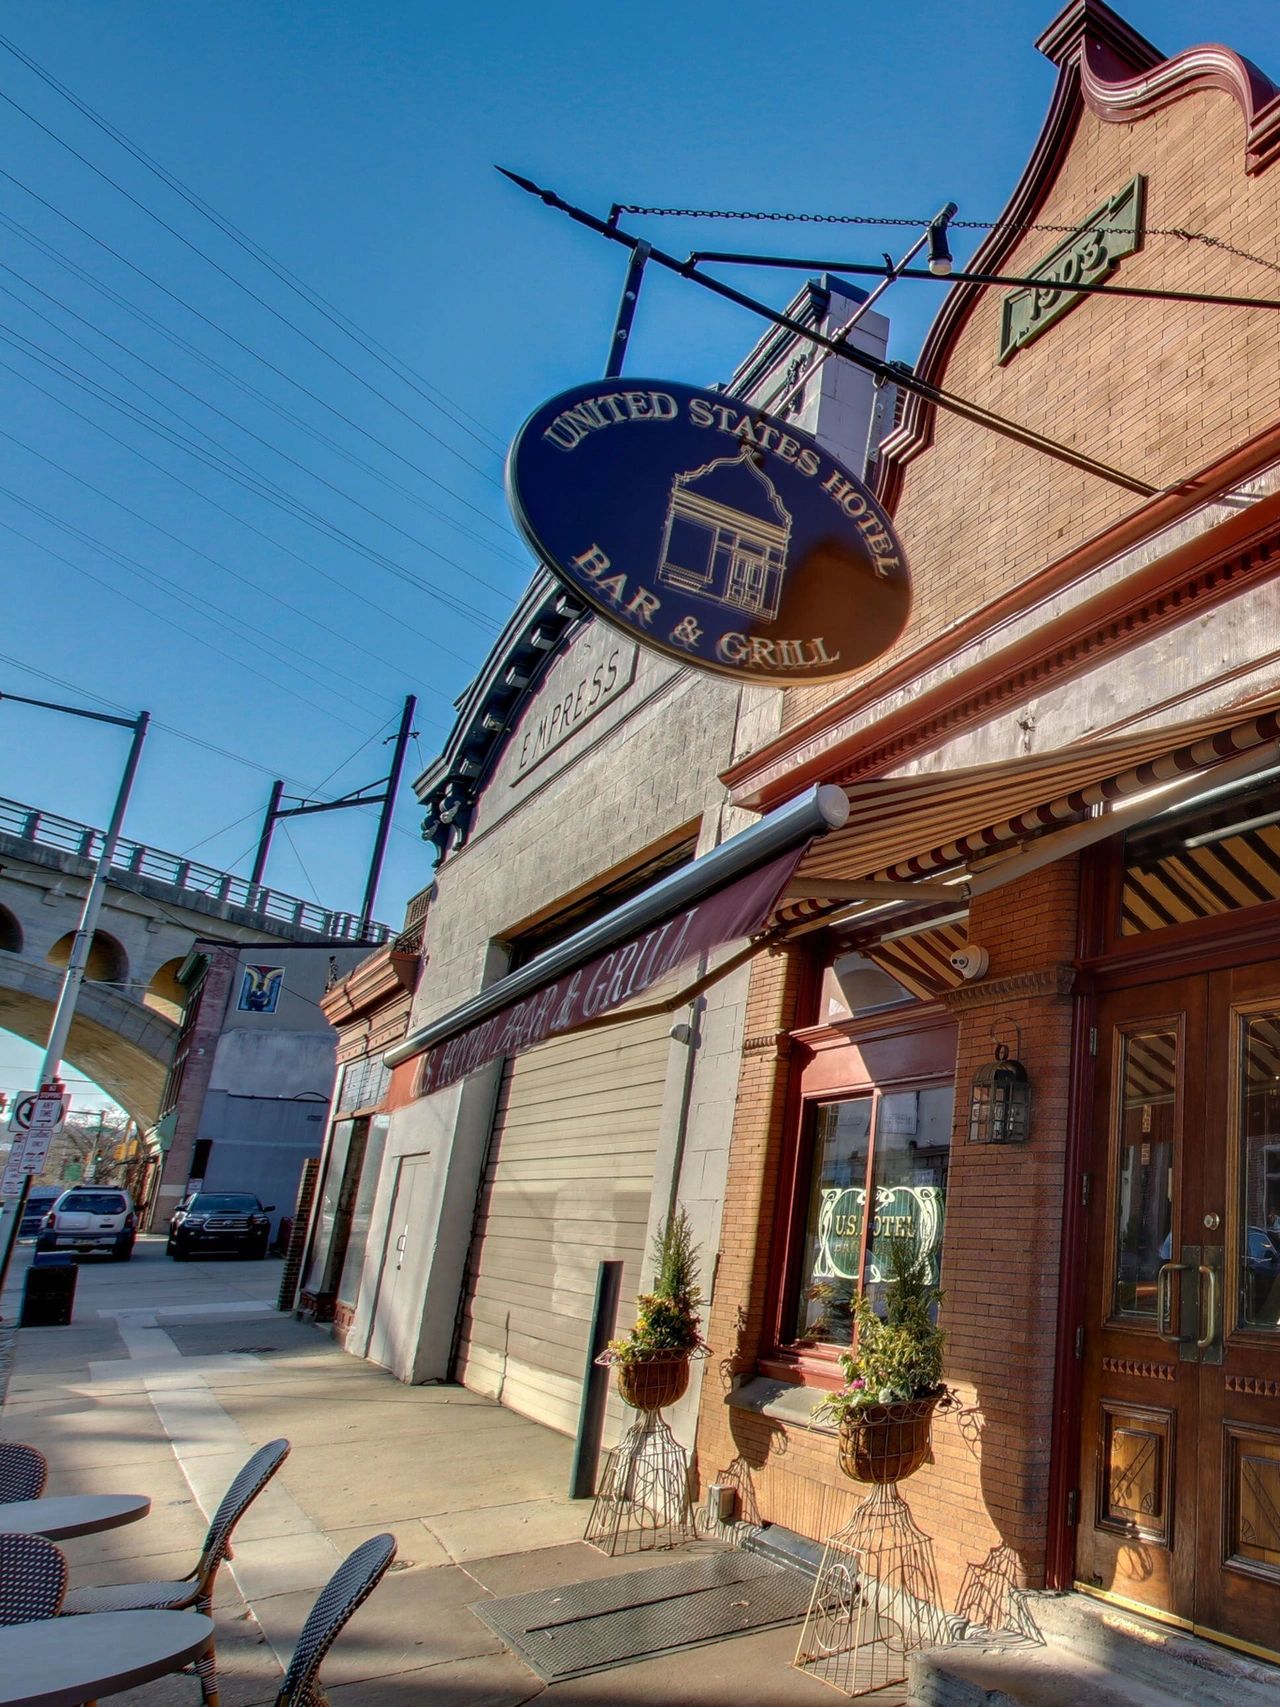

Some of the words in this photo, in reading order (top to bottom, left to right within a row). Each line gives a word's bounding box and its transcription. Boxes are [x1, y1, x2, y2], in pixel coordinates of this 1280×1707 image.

[542, 391, 678, 453] UNITED
[688, 397, 822, 477] STATES
[820, 469, 900, 579] HOTEL
[570, 543, 662, 628] BAR
[669, 615, 704, 651] &
[715, 631, 841, 671] GRILL
[518, 648, 620, 770] EMPRESS
